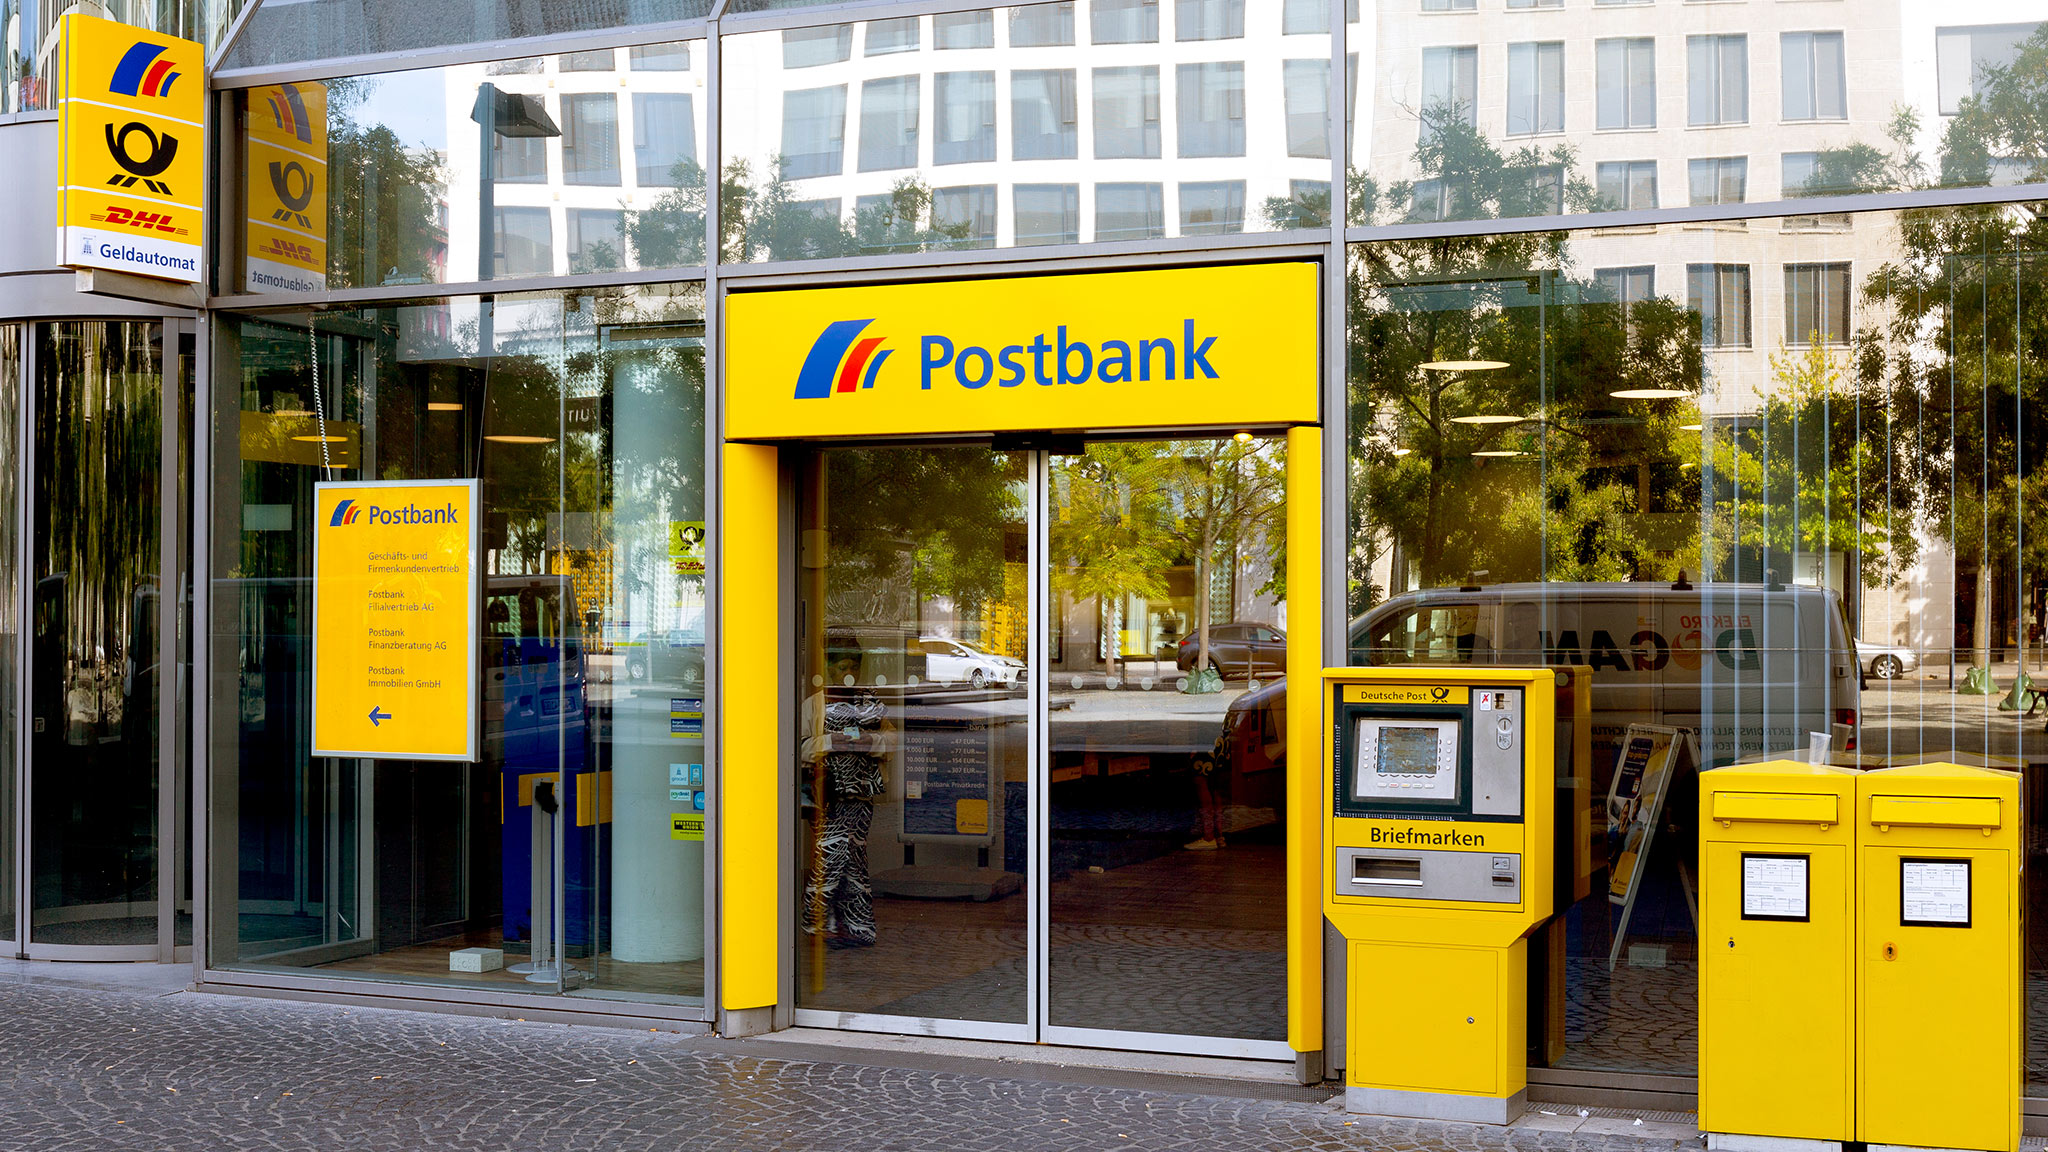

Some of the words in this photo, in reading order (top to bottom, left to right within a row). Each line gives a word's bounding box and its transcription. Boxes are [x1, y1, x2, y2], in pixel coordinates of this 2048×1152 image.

[104, 206, 176, 233] DHL
[99, 243, 195, 271] Geldautomat
[920, 318, 1220, 391] Postbank
[369, 502, 458, 525] Postbank
[368, 551, 410, 561] Geschäfts-
[411, 551, 428, 561] und
[368, 564, 460, 573] Firmenkundenvertrieb
[368, 602, 419, 612] Filialvertrieb
[421, 602, 434, 612] AG
[368, 628, 405, 637] Postbank
[368, 640, 432, 652] Finanzberatung
[434, 641, 447, 650] AG
[368, 665, 405, 675] Postbank
[368, 678, 414, 688] Immobilien
[415, 679, 441, 689] GmbH
[1360, 691, 1405, 700] Deutsche
[1406, 692, 1427, 700] Post
[1370, 827, 1485, 846] Briefmarken
